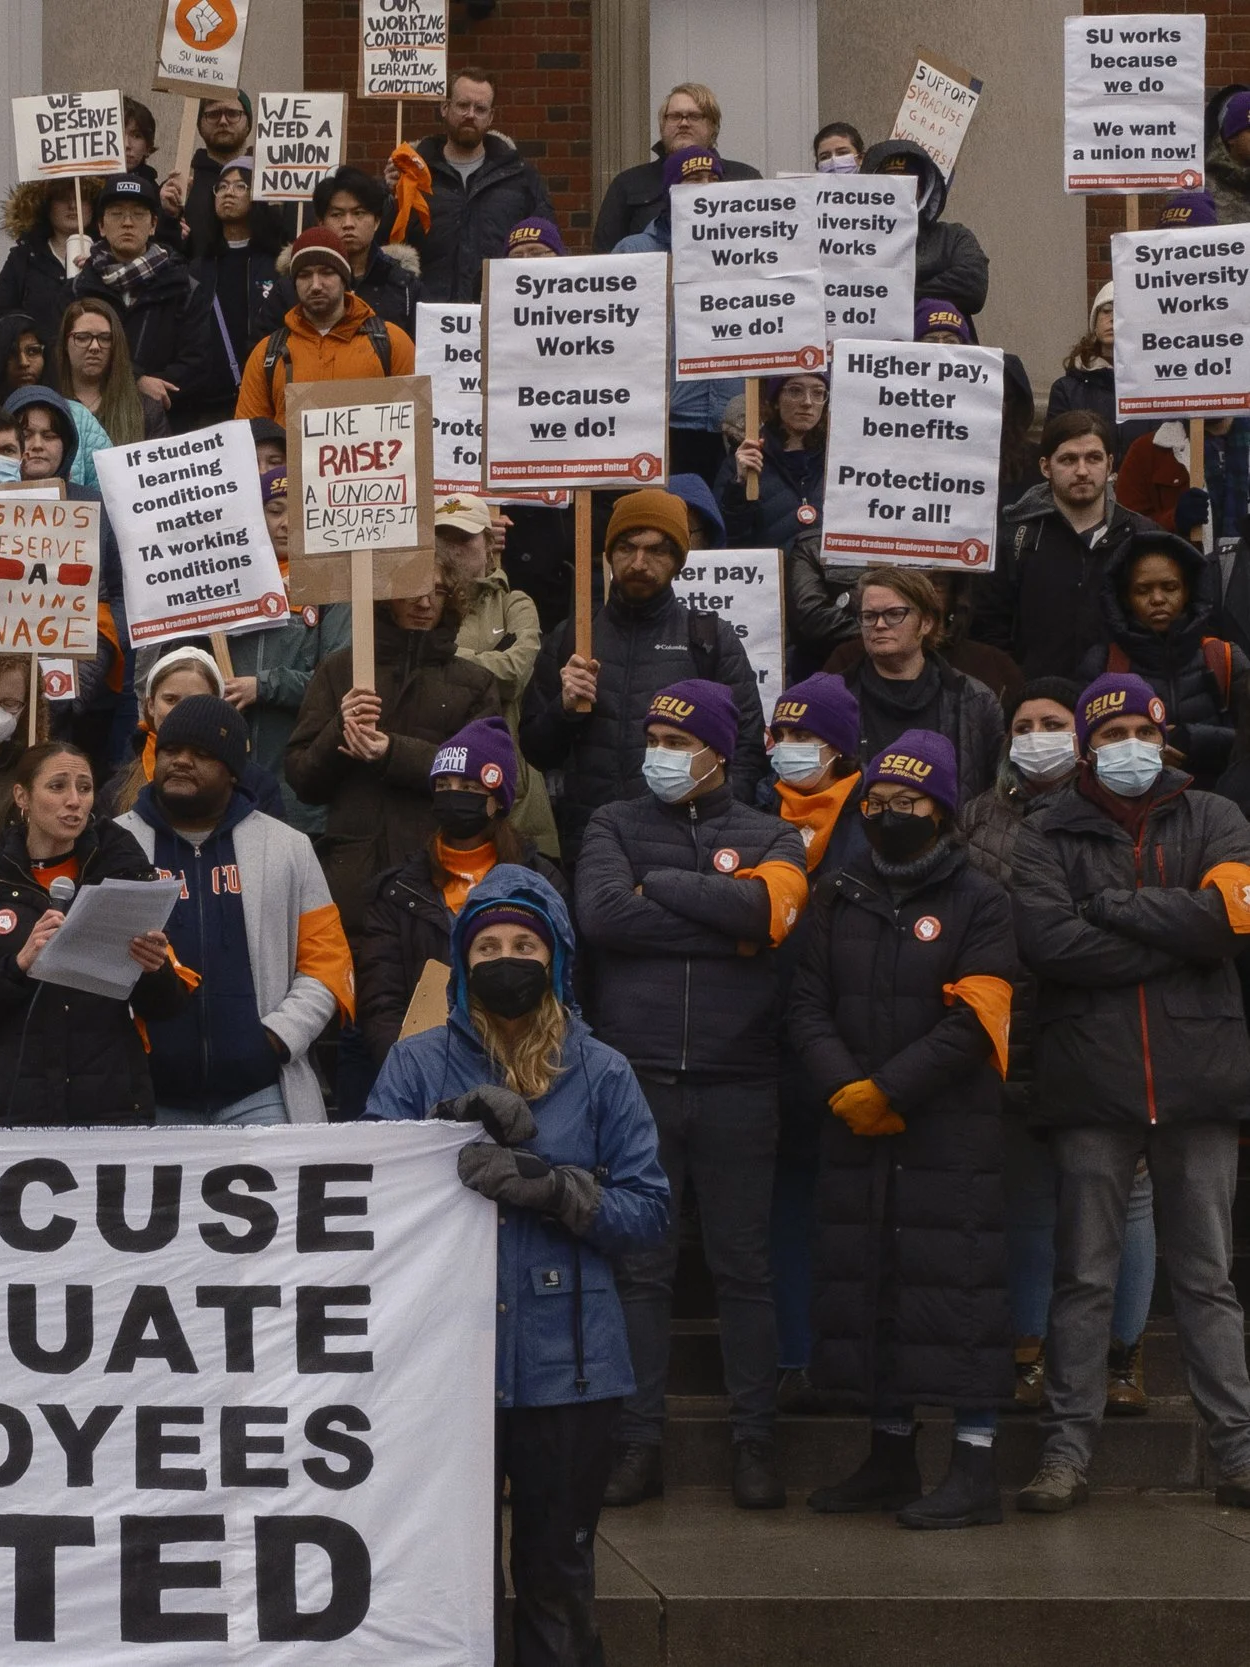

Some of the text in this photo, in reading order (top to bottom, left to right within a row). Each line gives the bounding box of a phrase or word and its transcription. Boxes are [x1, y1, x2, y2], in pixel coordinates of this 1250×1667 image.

[367, 14, 445, 31] WORKING
[364, 31, 446, 47] CONDITIONS
[1086, 28, 1181, 44] SU works
[179, 50, 218, 65] SU WORKS
[388, 48, 418, 62] YOUR
[1091, 54, 1177, 68] because
[167, 63, 194, 77] BECAUSE
[197, 69, 209, 78] WE
[371, 63, 437, 76] LEARNING
[368, 78, 445, 95] CONDITIONS
[916, 65, 976, 109] SUPPORT
[1104, 77, 1163, 93] we do
[47, 93, 83, 108] WE
[261, 97, 311, 120] WE
[907, 84, 964, 127] SYRACUSE
[36, 107, 118, 134] DESERVE
[258, 120, 332, 138] NEED A
[909, 110, 946, 135] GRAD
[1094, 121, 1176, 136] We want
[41, 130, 119, 163] BETTER
[267, 143, 329, 165] UNION
[1073, 143, 1196, 160] a union now!
[118, 183, 139, 192] VANS
[694, 197, 796, 218] Syracuse
[692, 221, 798, 241] University
[711, 248, 778, 266] Works
[1136, 242, 1245, 266] Syracuse
[516, 275, 636, 299] Syracuse
[1136, 266, 1248, 289] University
[700, 293, 795, 312] Because
[1158, 295, 1228, 314] Works
[514, 304, 639, 327] University
[928, 311, 962, 325] SEIU
[712, 317, 783, 338] we do!
[536, 336, 614, 356] Works
[1143, 333, 1243, 350] Because
[848, 354, 988, 383] Higher pay,
[1154, 358, 1231, 378] we do!
[519, 387, 630, 406] Because
[879, 386, 956, 408] better
[304, 405, 412, 438] LIKE THE
[530, 417, 615, 439] we do!
[863, 417, 968, 440] benefits
[126, 433, 224, 467] If student
[319, 439, 403, 477] RAISE?
[138, 459, 223, 489] learning
[492, 462, 629, 475] Syracuse Graduate Employees United
[839, 466, 985, 495] Protections
[132, 480, 238, 514] conditions
[305, 483, 400, 505] A UNION
[157, 508, 222, 533] matter
[306, 506, 417, 530] ENSURES IT
[868, 499, 951, 523] for all!
[139, 528, 249, 561] TA working
[323, 525, 387, 547] STAYS!
[826, 537, 958, 555] Syracuse Graduate Employees United
[28, 564, 47, 585] A
[146, 555, 251, 588] conditions
[166, 579, 241, 606] matter!
[1085, 691, 1126, 721] SEIU
[880, 754, 933, 778] SEIU
